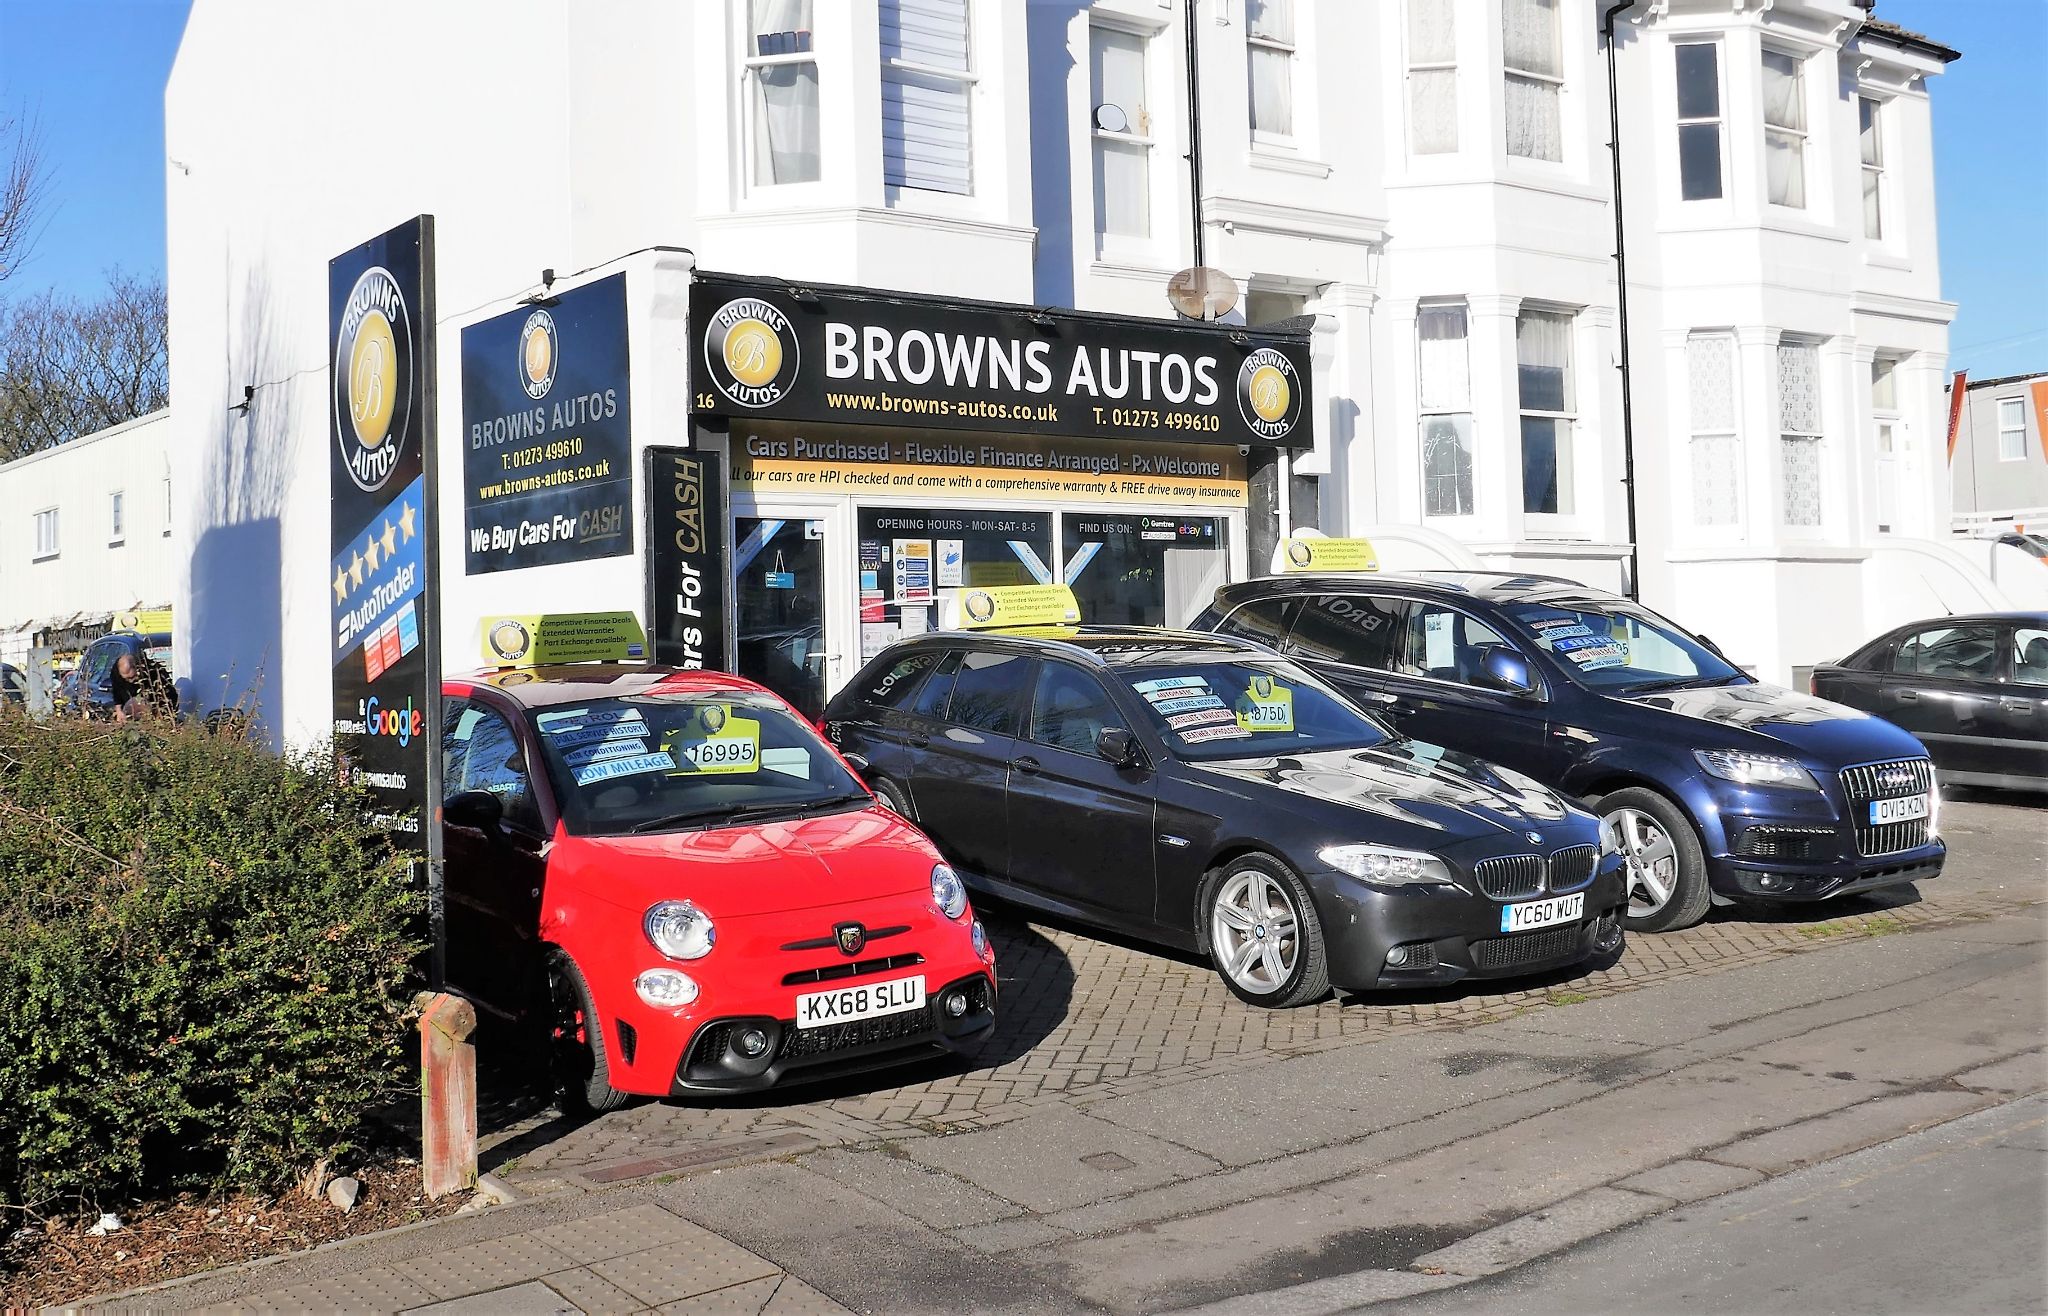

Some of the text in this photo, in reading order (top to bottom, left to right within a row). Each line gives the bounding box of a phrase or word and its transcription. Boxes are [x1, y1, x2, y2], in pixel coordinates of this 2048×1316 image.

[346, 268, 400, 340] BROWNS
[523, 311, 552, 340] BROWNS
[718, 303, 786, 332] BROWNS
[825, 322, 1220, 406] BROWNS AUTOS
[1246, 351, 1292, 377] BROWNS
[528, 374, 552, 399] AUTOS
[727, 382, 781, 404] AUTOS
[696, 393, 715, 409] 16
[827, 392, 1221, 432] www.browns-autos.co.uk T. 01273 499610
[471, 388, 618, 450] BROWNS AUTOS
[1251, 419, 1289, 436] AUTOS
[351, 434, 396, 482] AUTOS
[502, 437, 583, 470] T: 01273 499610
[745, 435, 789, 458] Cars
[793, 437, 890, 462] Purchased
[905, 443, 975, 465] Flexible
[980, 446, 1044, 468] Finance
[1047, 450, 1120, 476] Arranged
[1132, 455, 1152, 473] Px
[1153, 456, 1221, 476] Welcome
[479, 458, 610, 500] www.browns-autos.co.uk
[730, 467, 1241, 499] ll our cars are HPI checked and come with a comprehensive warranty & FREE drive away insurance
[675, 457, 700, 554] CASH
[470, 504, 622, 555] We Buy Cars For CASH
[877, 518, 924, 530] OPENING
[927, 519, 963, 531] HOURS
[1021, 522, 1036, 533] 8-5
[1079, 523, 1133, 535] FIND US ON:
[1151, 519, 1175, 528] Gumtree
[1178, 522, 1201, 538] ebay
[350, 562, 415, 638] AutoTrader
[676, 562, 703, 618] For
[540, 616, 632, 627] Competitive Finance Deals
[542, 627, 615, 637] Extended Warranties
[544, 636, 627, 647] Part Exchange available
[500, 650, 525, 660] AUTOS
[1154, 679, 1184, 687] DIESEL
[1157, 689, 1194, 698] AUTOMATIC
[1158, 698, 1219, 711] FULL SERVICE HISTORY
[366, 696, 422, 747] Google
[1173, 710, 1235, 726] SATELLITE NAVIGATION
[555, 725, 643, 743] FULL SERVICE HISTORY
[1184, 725, 1246, 740] LEATHER UPHOLSTERY
[568, 743, 641, 761] AIR CONDITIONING
[576, 755, 670, 781] LOW MILEAGE
[1881, 797, 1925, 819] OV13 KZN
[1514, 903, 1553, 926] YC60
[1556, 896, 1581, 919] WUT
[807, 980, 916, 1020] KX68 SLU
